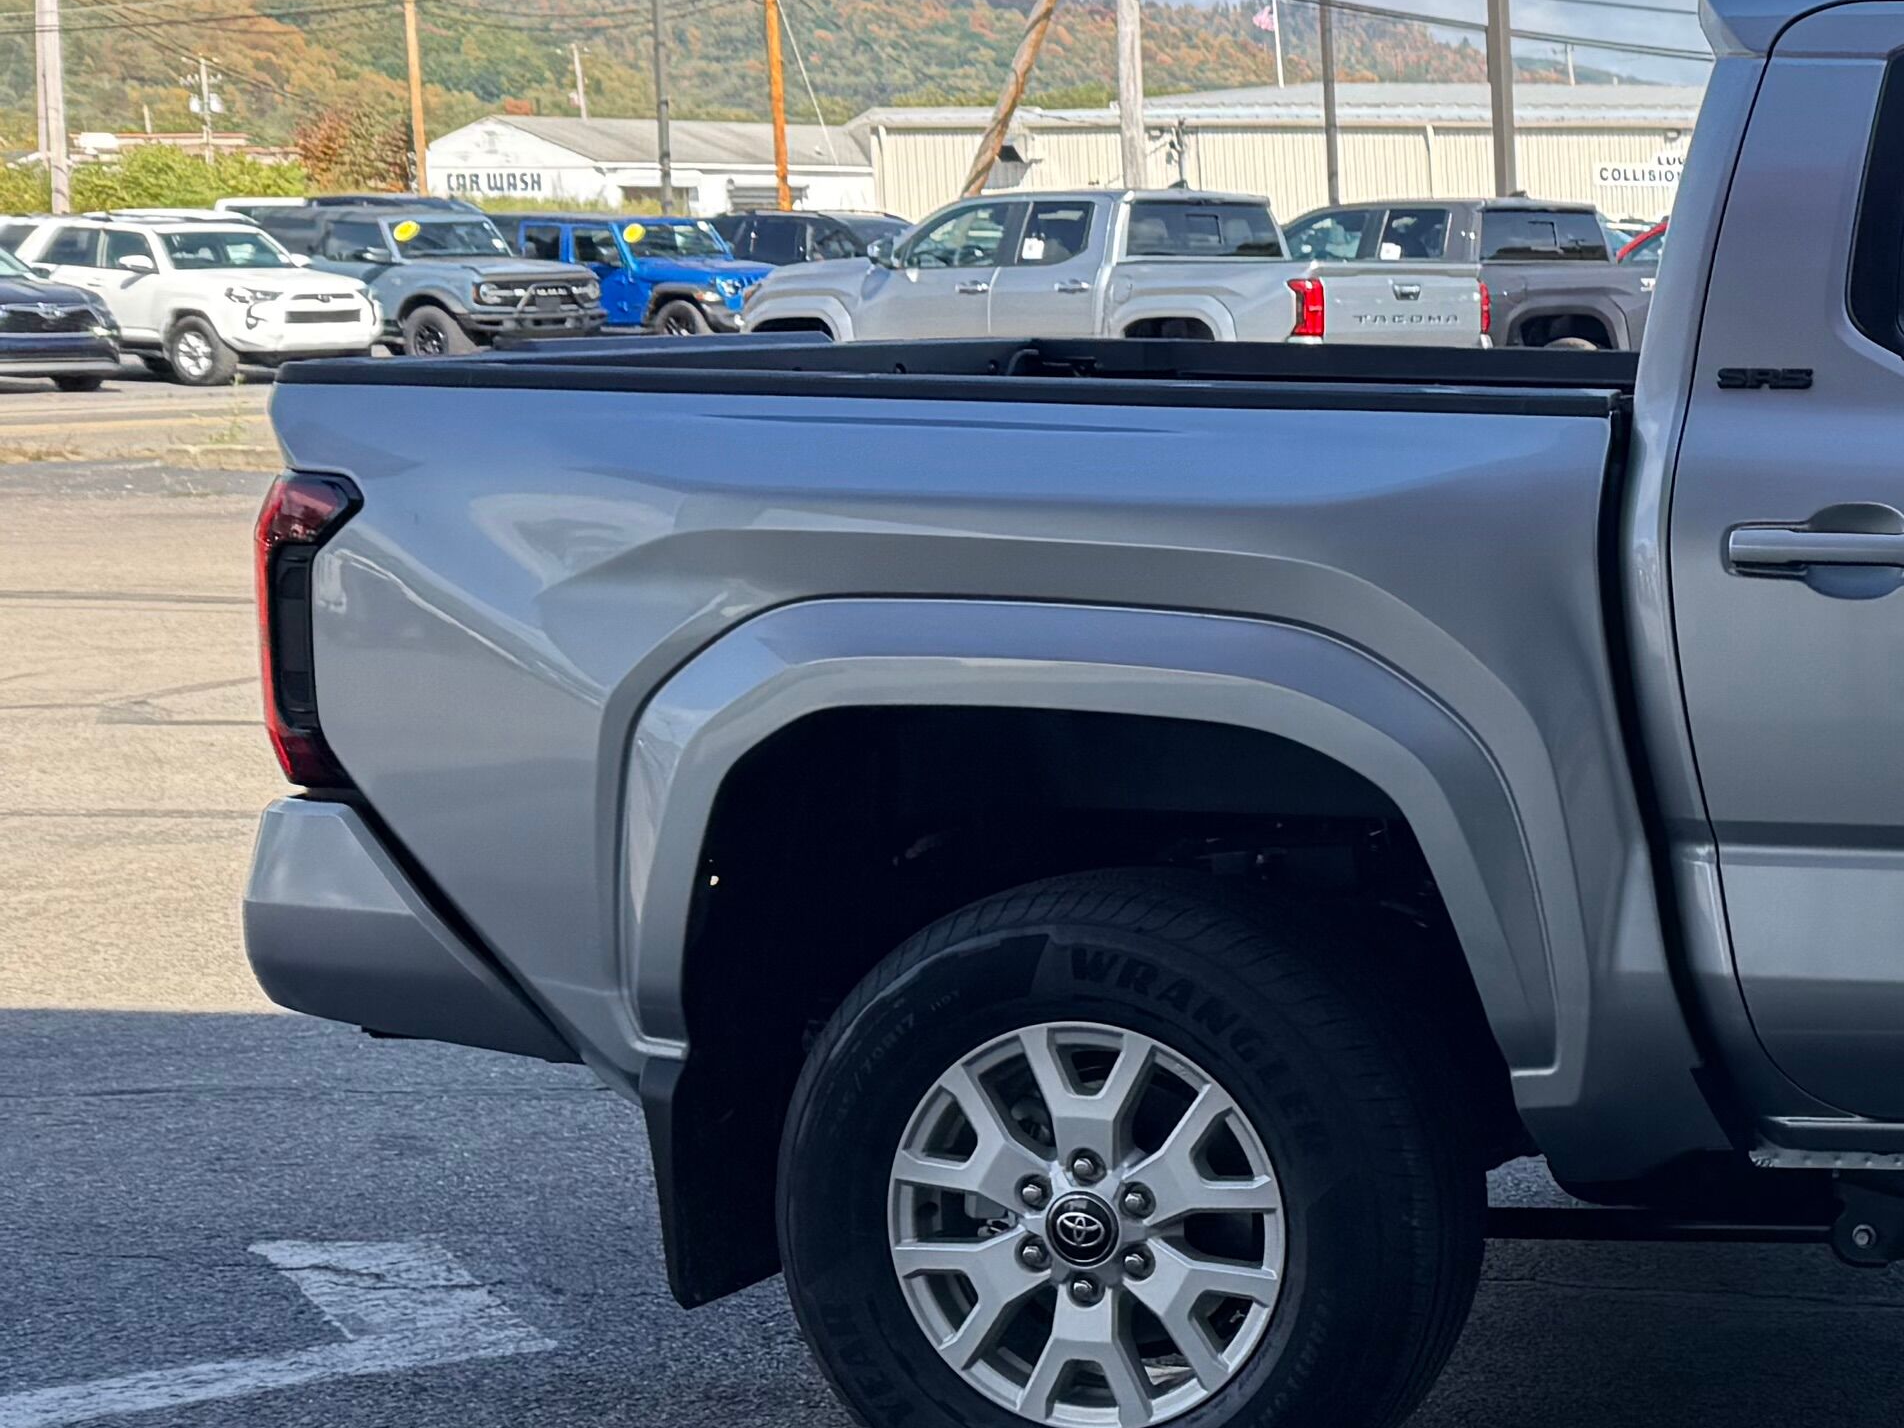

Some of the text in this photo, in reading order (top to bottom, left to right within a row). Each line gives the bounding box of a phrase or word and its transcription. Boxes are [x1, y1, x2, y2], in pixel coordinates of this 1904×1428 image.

[446, 172, 542, 192] CAR WASH
[1599, 167, 1682, 183] COLLISIO
[1352, 313, 1460, 324] TACOMA
[1716, 368, 1814, 390] SR5
[1070, 946, 1332, 1155] WRANGLER
